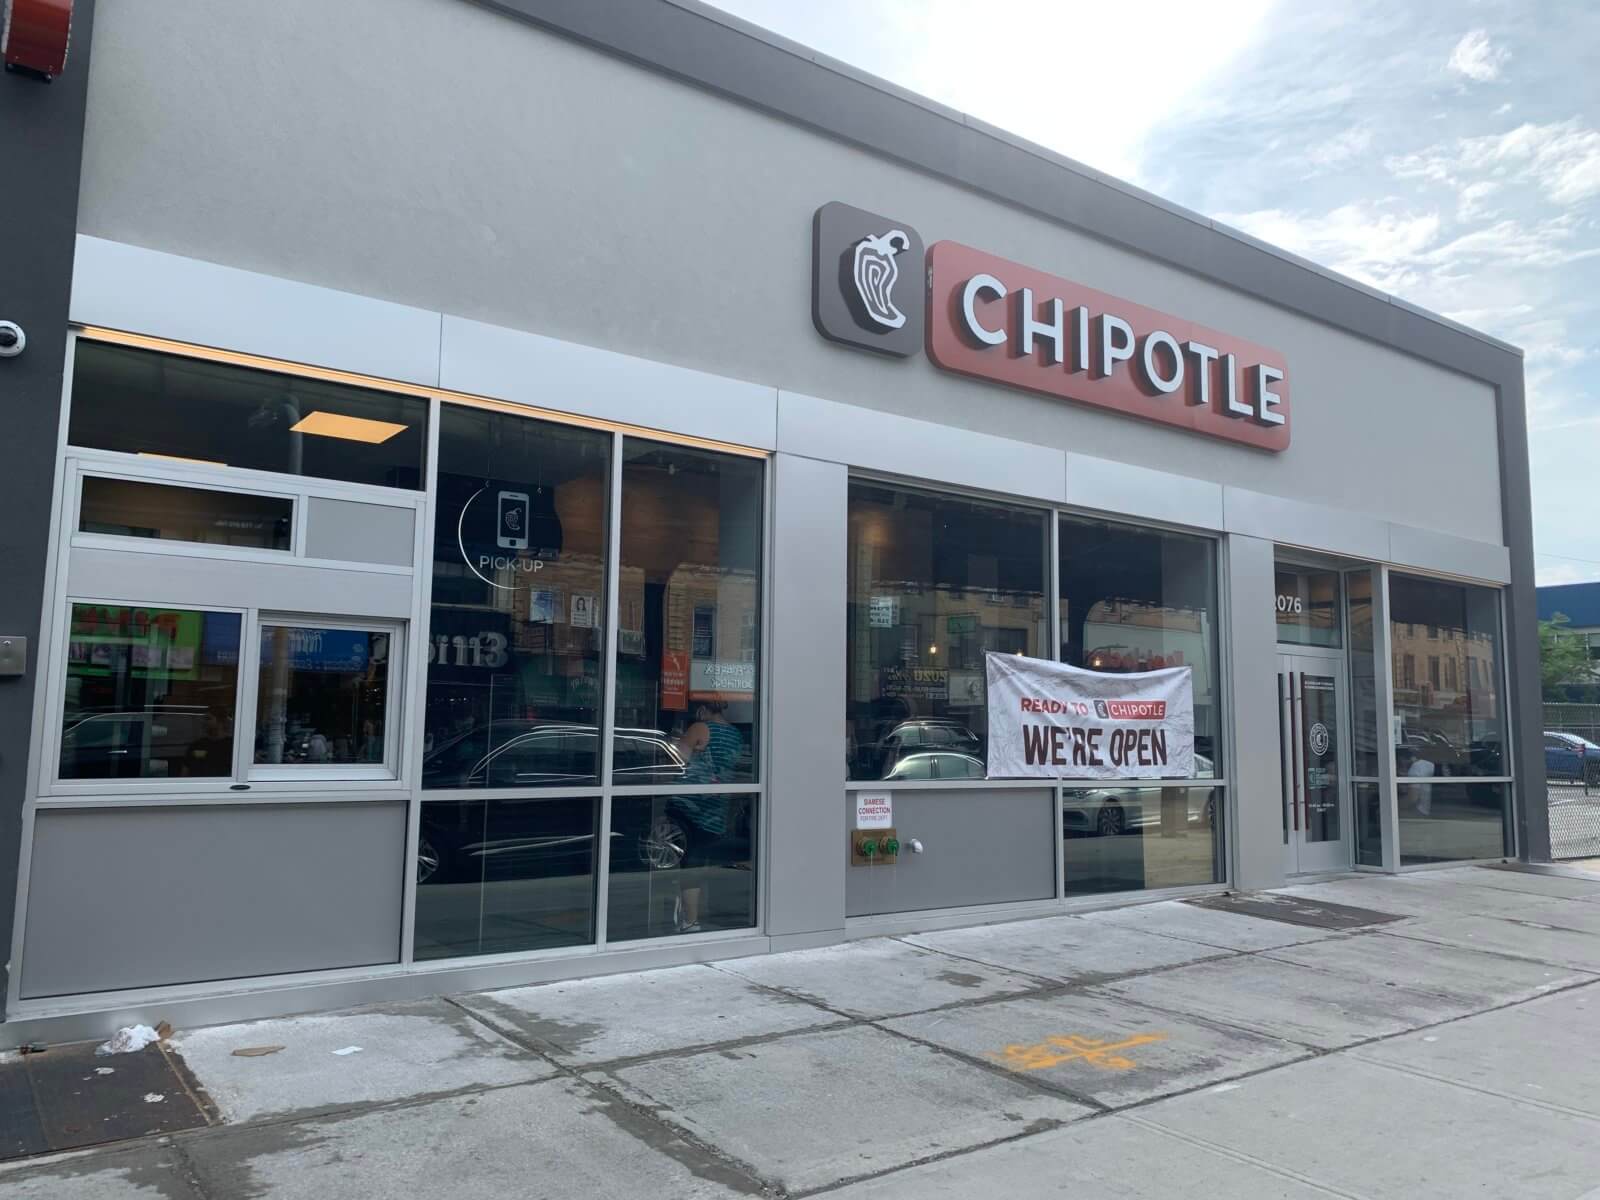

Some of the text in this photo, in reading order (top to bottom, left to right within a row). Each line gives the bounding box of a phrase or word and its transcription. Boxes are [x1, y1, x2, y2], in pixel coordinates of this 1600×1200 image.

[962, 273, 1285, 426] CHIPOTLE
[480, 555, 544, 573] PICK-UP
[1274, 595, 1302, 613] 076
[1020, 697, 1165, 716] READY TO CHIPOTLE
[1022, 724, 1168, 767] WE'RE OPEN
[858, 807, 891, 815] CONNECTION
